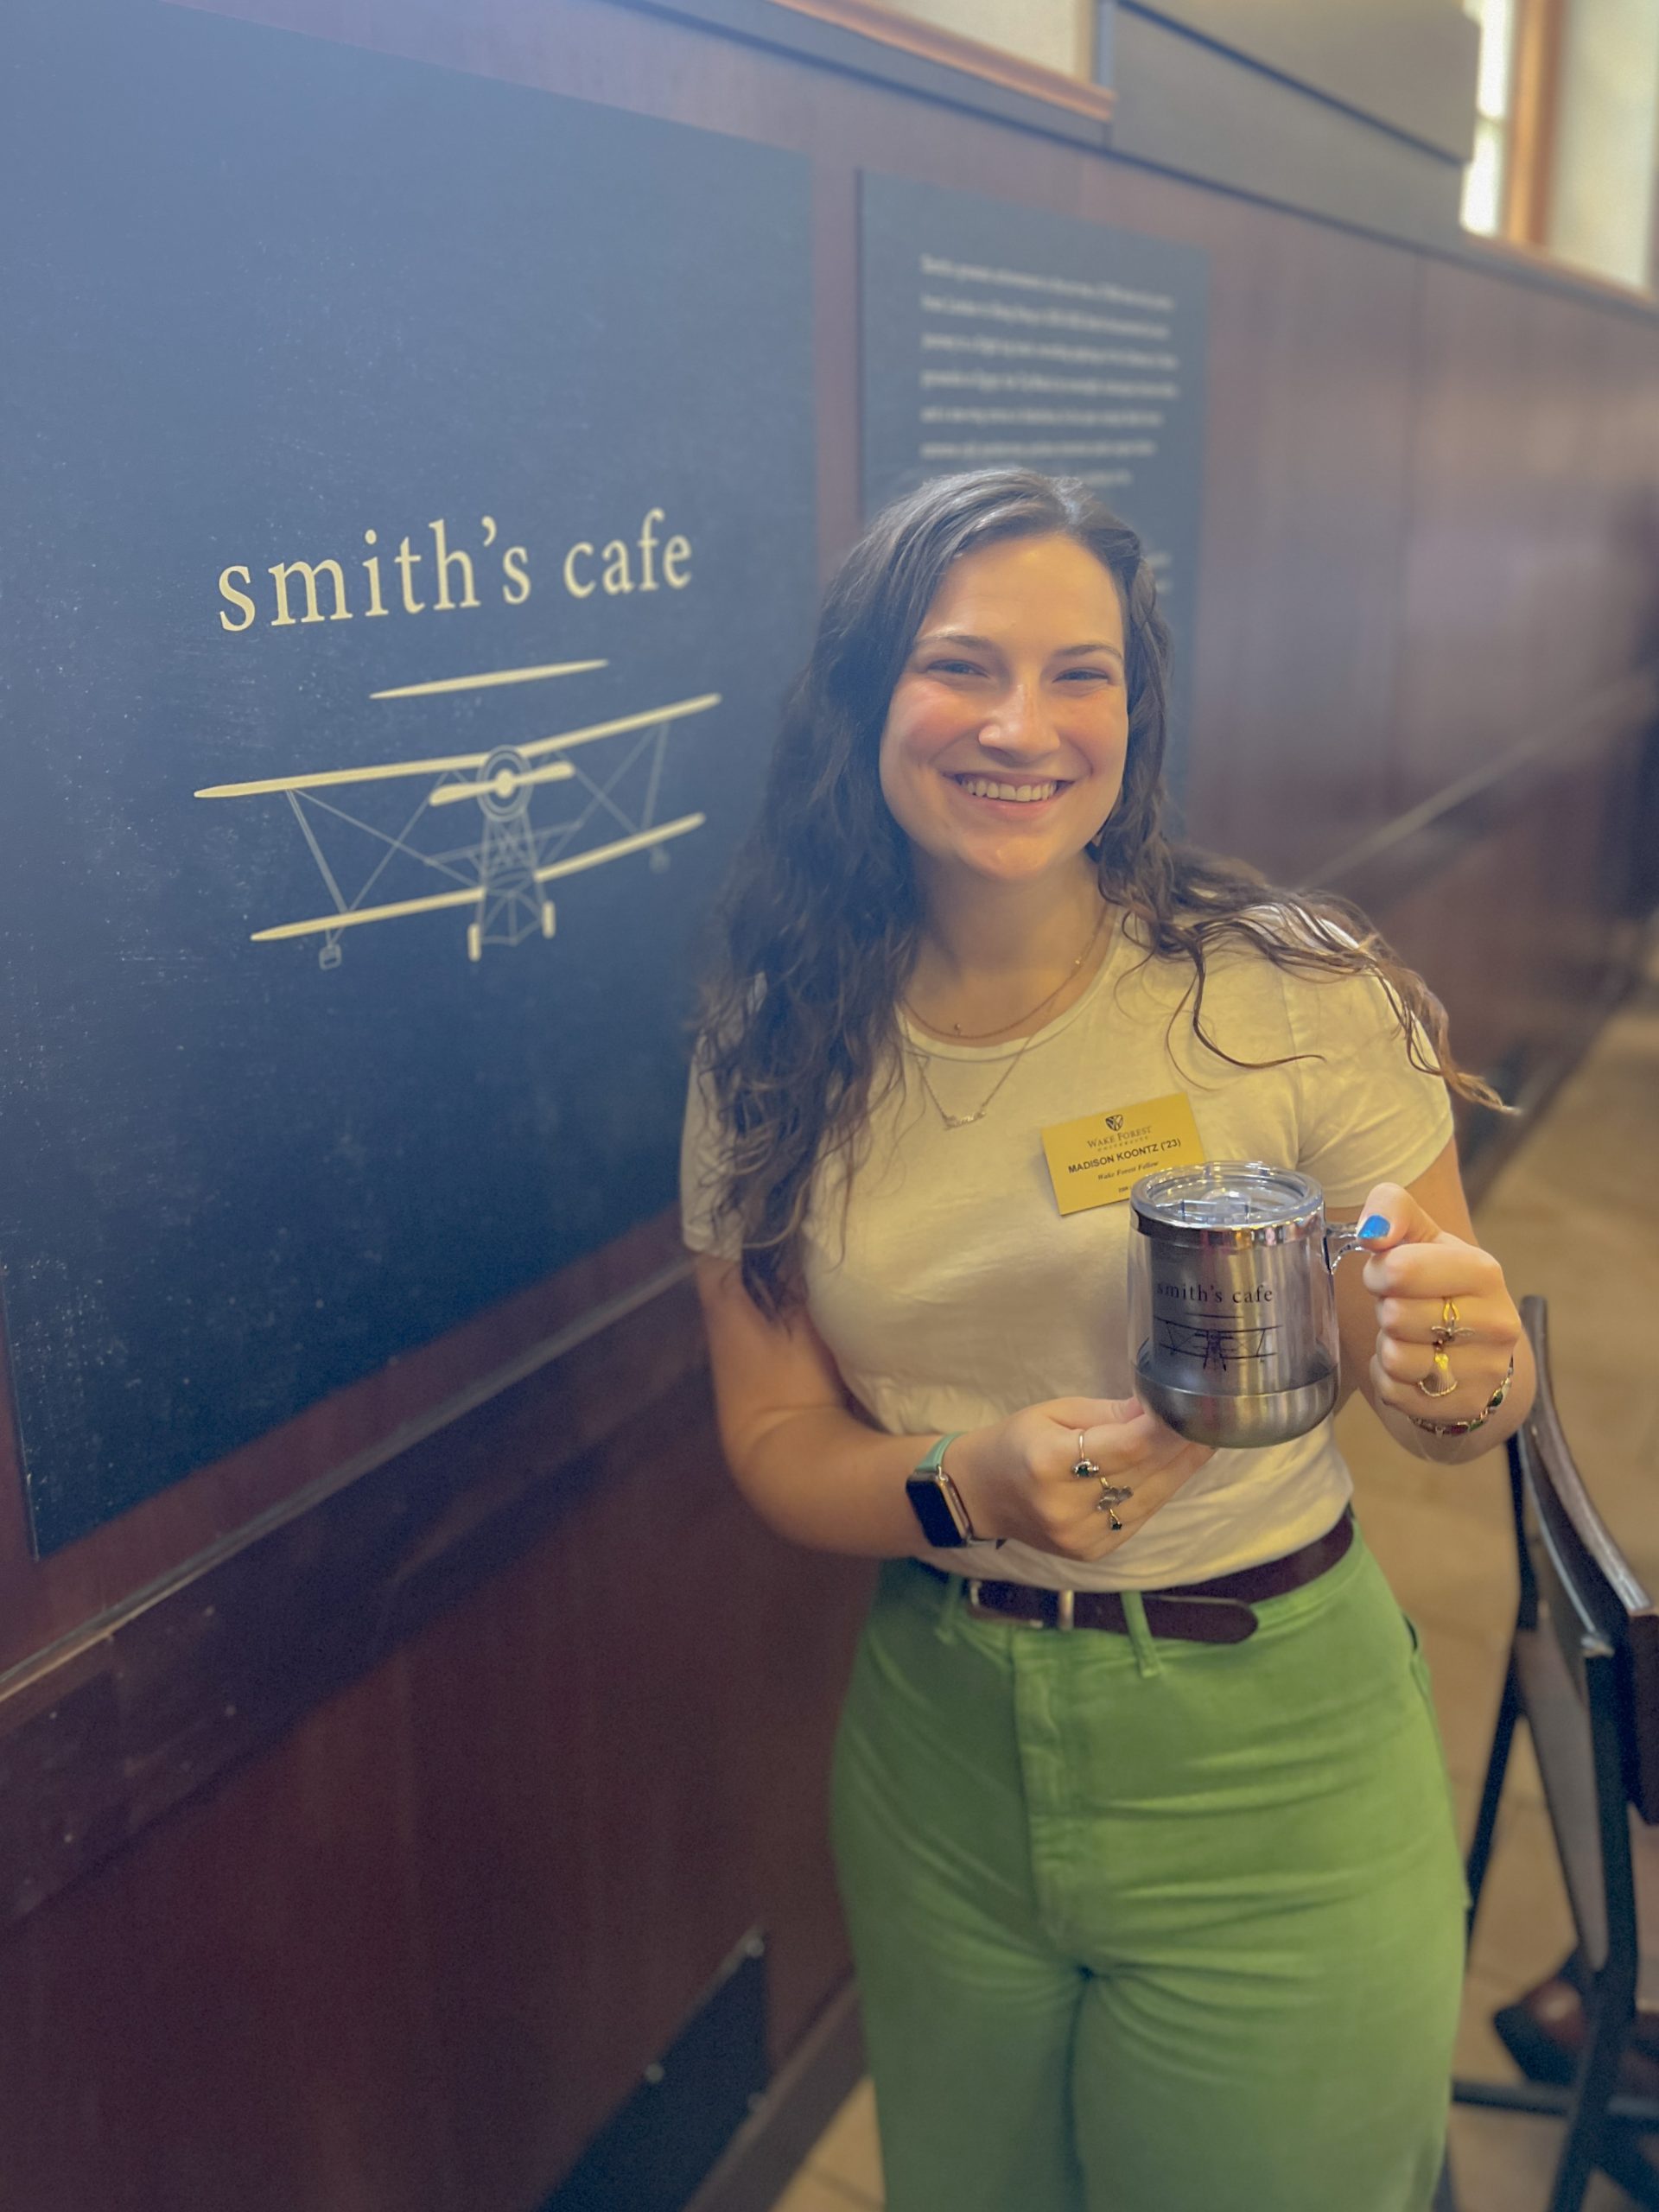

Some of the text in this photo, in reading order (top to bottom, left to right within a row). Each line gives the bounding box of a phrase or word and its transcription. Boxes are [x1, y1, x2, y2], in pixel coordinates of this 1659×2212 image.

[219, 508, 691, 632] smith's cafe
[1087, 1126, 1153, 1149] WAKE FOREST
[1068, 1155, 1115, 1173] MADISON
[1116, 1143, 1159, 1161] KOONTZ
[1097, 1172, 1116, 1180] Wake
[1116, 1166, 1136, 1176] Forest
[1157, 1282, 1273, 1304] smith's cafe
